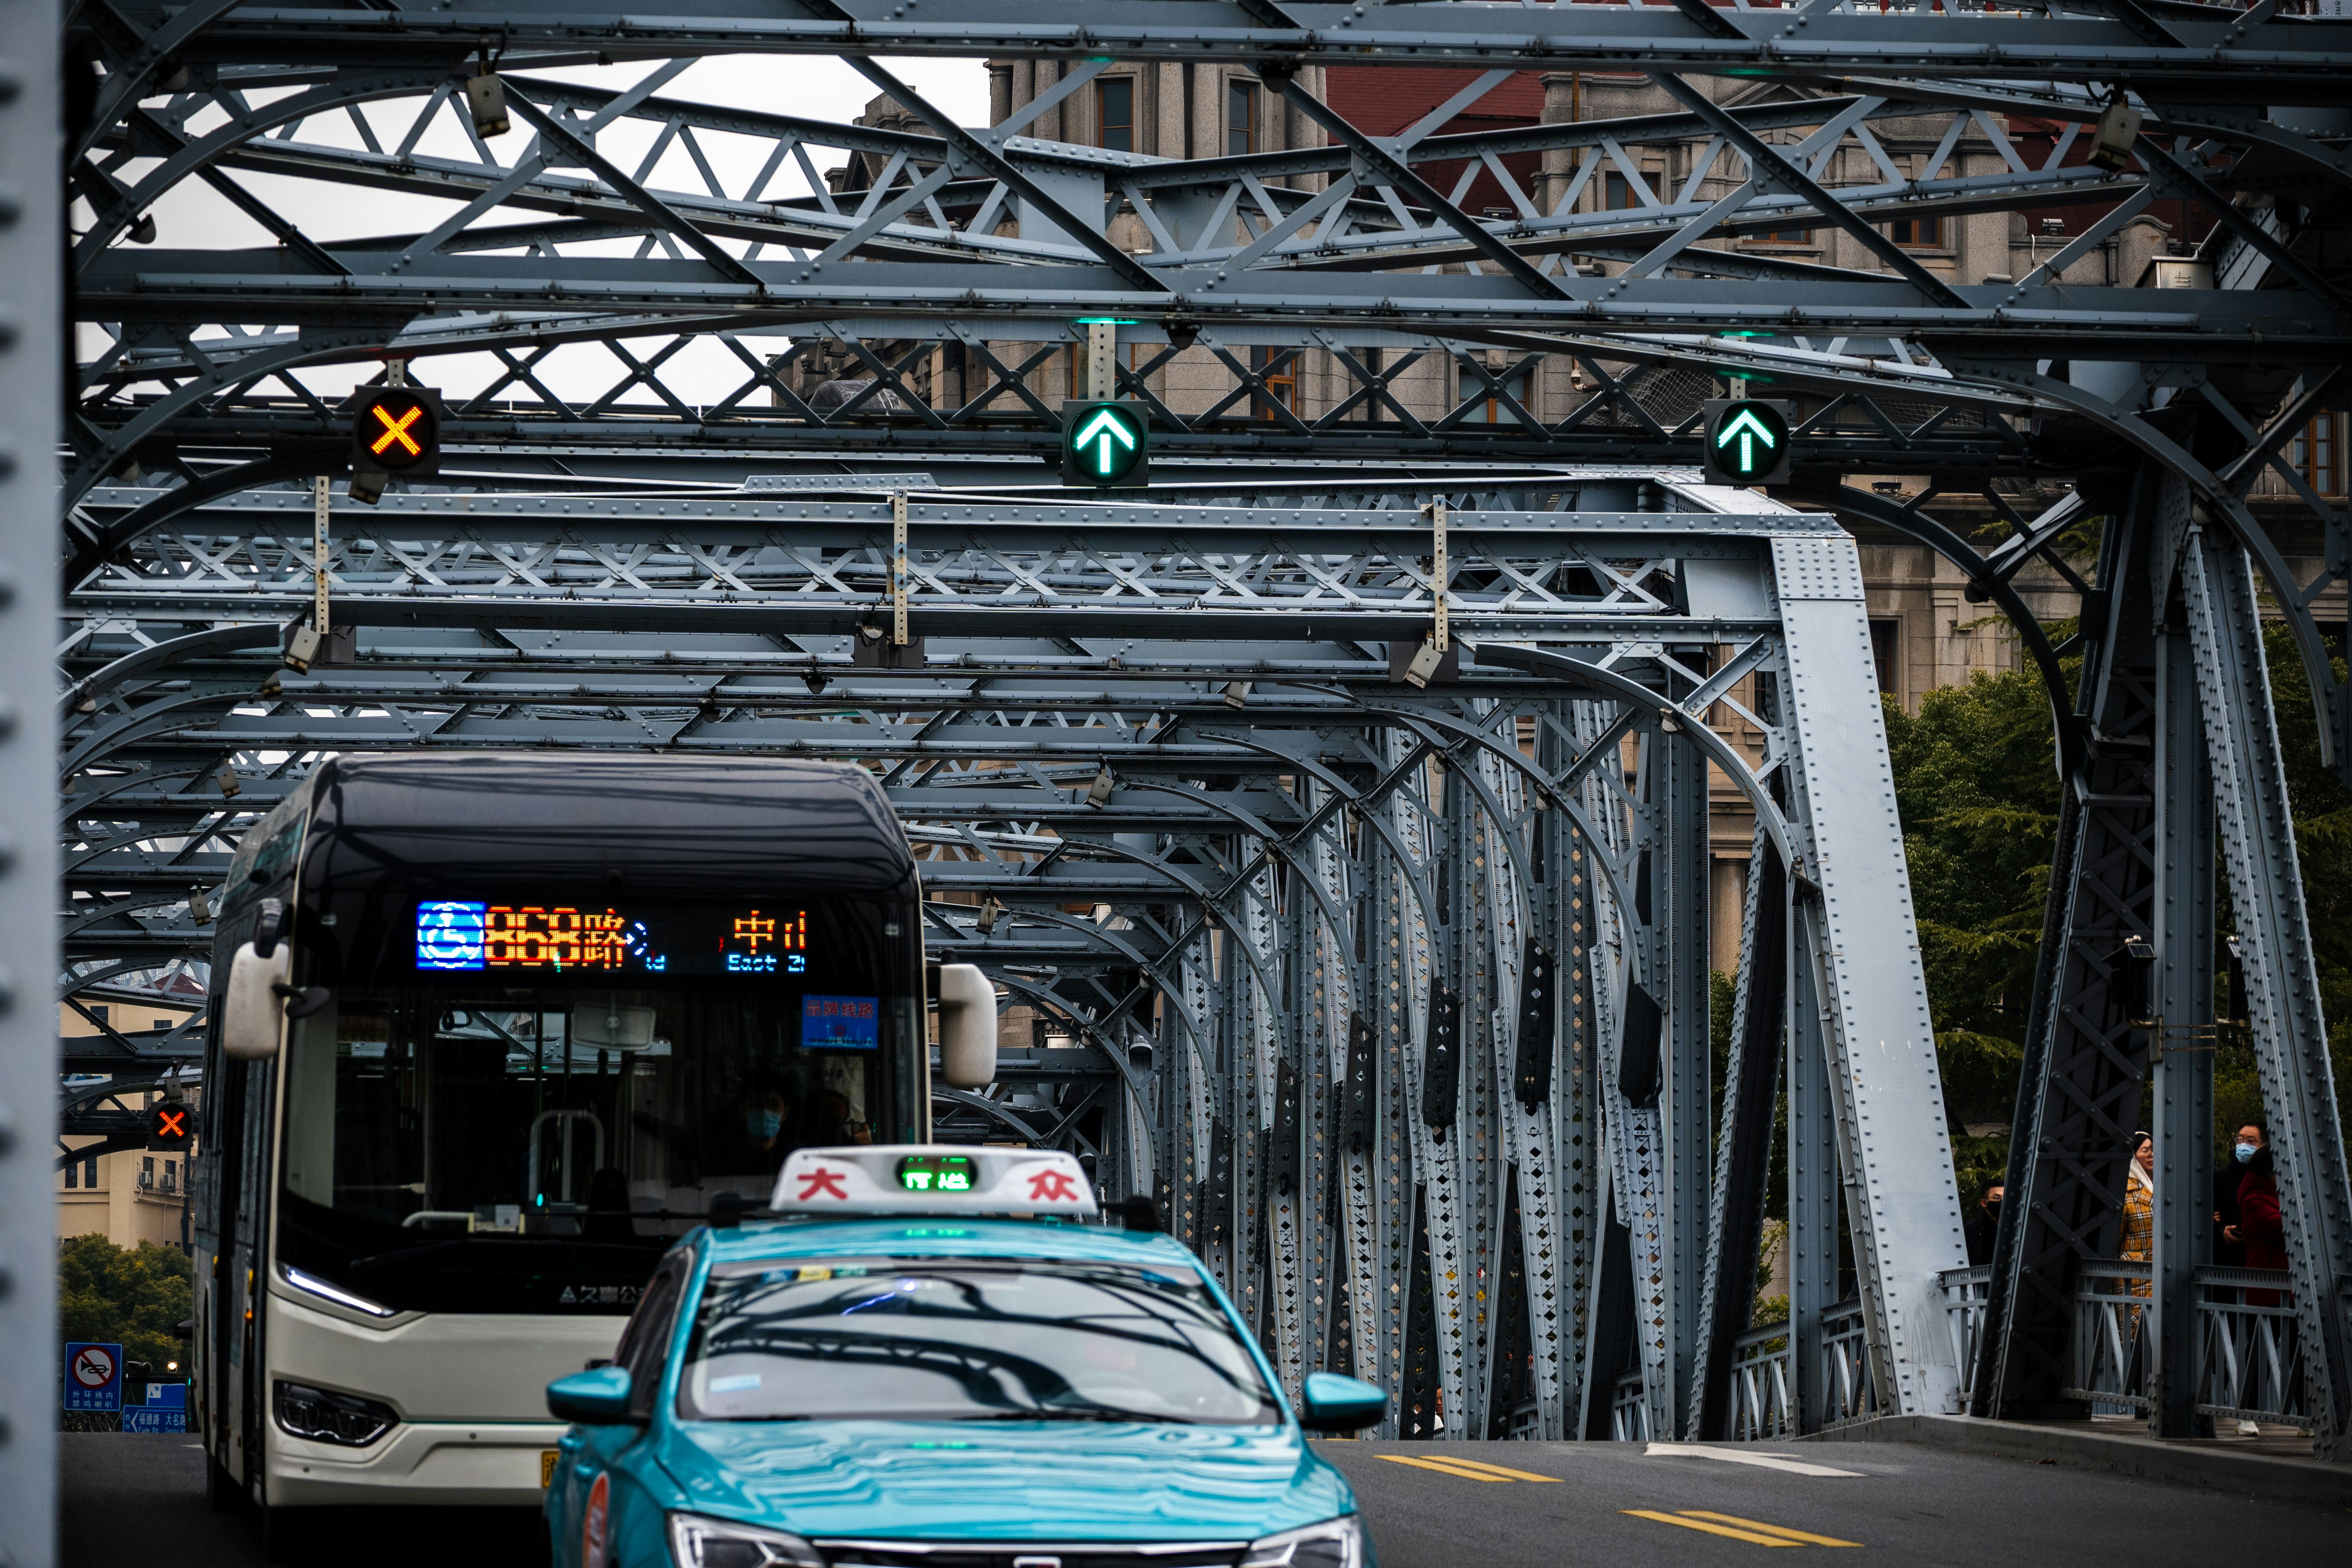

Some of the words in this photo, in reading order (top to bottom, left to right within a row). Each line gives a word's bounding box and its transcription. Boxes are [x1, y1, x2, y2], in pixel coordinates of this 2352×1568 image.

[806, 1000, 874, 1019] 品牌线路
[798, 1168, 848, 1200] 大
[1027, 1169, 1079, 1201] 众
[579, 1285, 645, 1303] 久事公
[73, 1391, 113, 1399] 外环线内
[73, 1400, 112, 1408] 禁鸣喇叭
[139, 1413, 159, 1425] 福德路
[166, 1413, 185, 1426] 大名路
